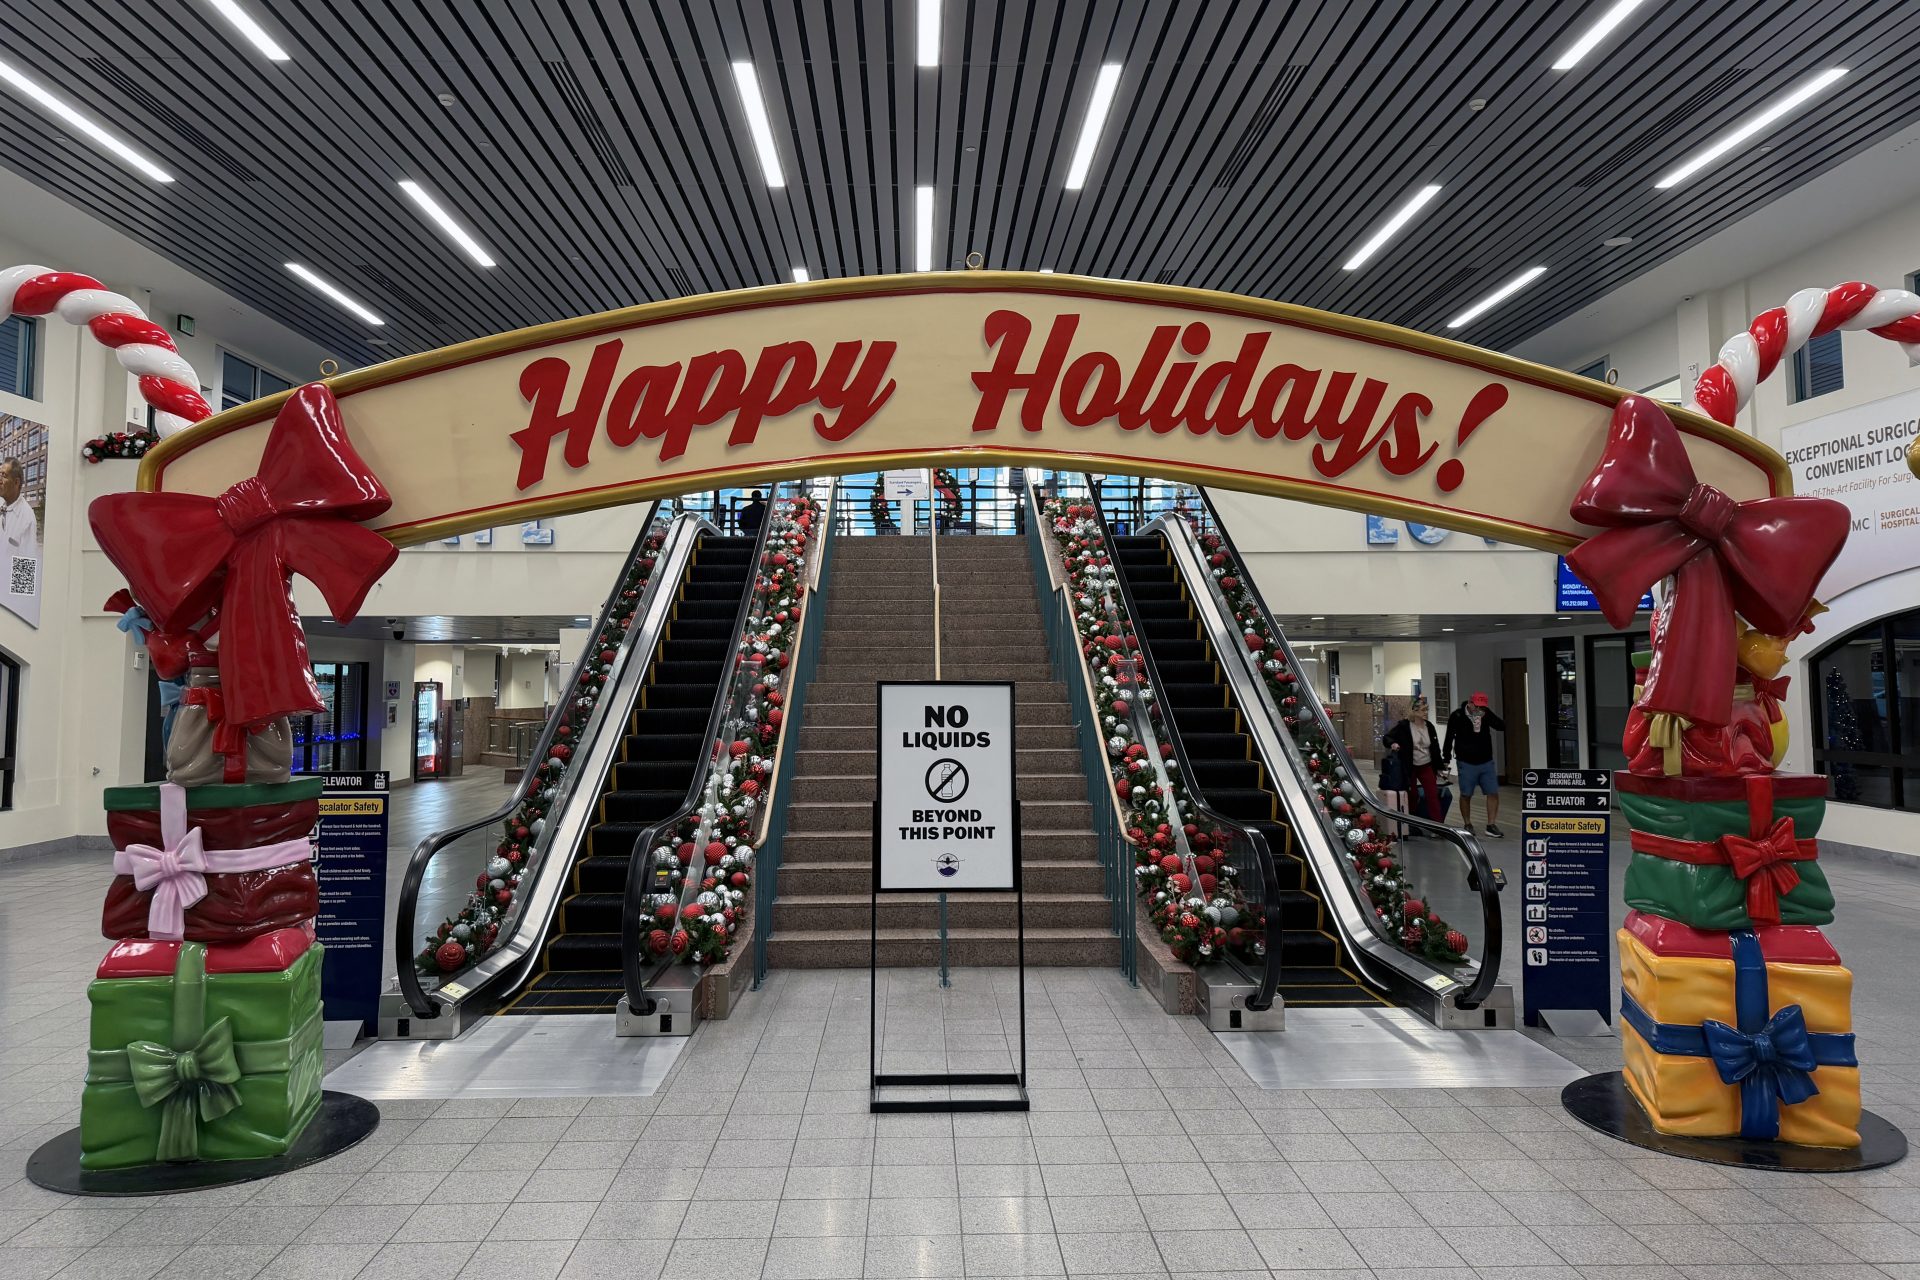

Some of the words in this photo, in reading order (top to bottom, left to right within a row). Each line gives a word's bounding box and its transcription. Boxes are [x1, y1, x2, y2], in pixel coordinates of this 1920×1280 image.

[510, 338, 897, 490] Happy
[971, 310, 1508, 492] Holidays!
[1786, 434, 1864, 465] EXCEPTIONAL
[1806, 450, 1883, 480] CONVENIENT
[1850, 478, 1877, 492] Facility
[1878, 476, 1891, 486] For
[1880, 506, 1920, 520] SURGICAL
[1881, 516, 1920, 530] HOSPITAL
[320, 802, 352, 812] scalator
[353, 802, 379, 813] Safety
[1546, 796, 1586, 806] ELEVATOR
[1542, 820, 1576, 830] Escalator
[1578, 822, 1602, 832] Safety
